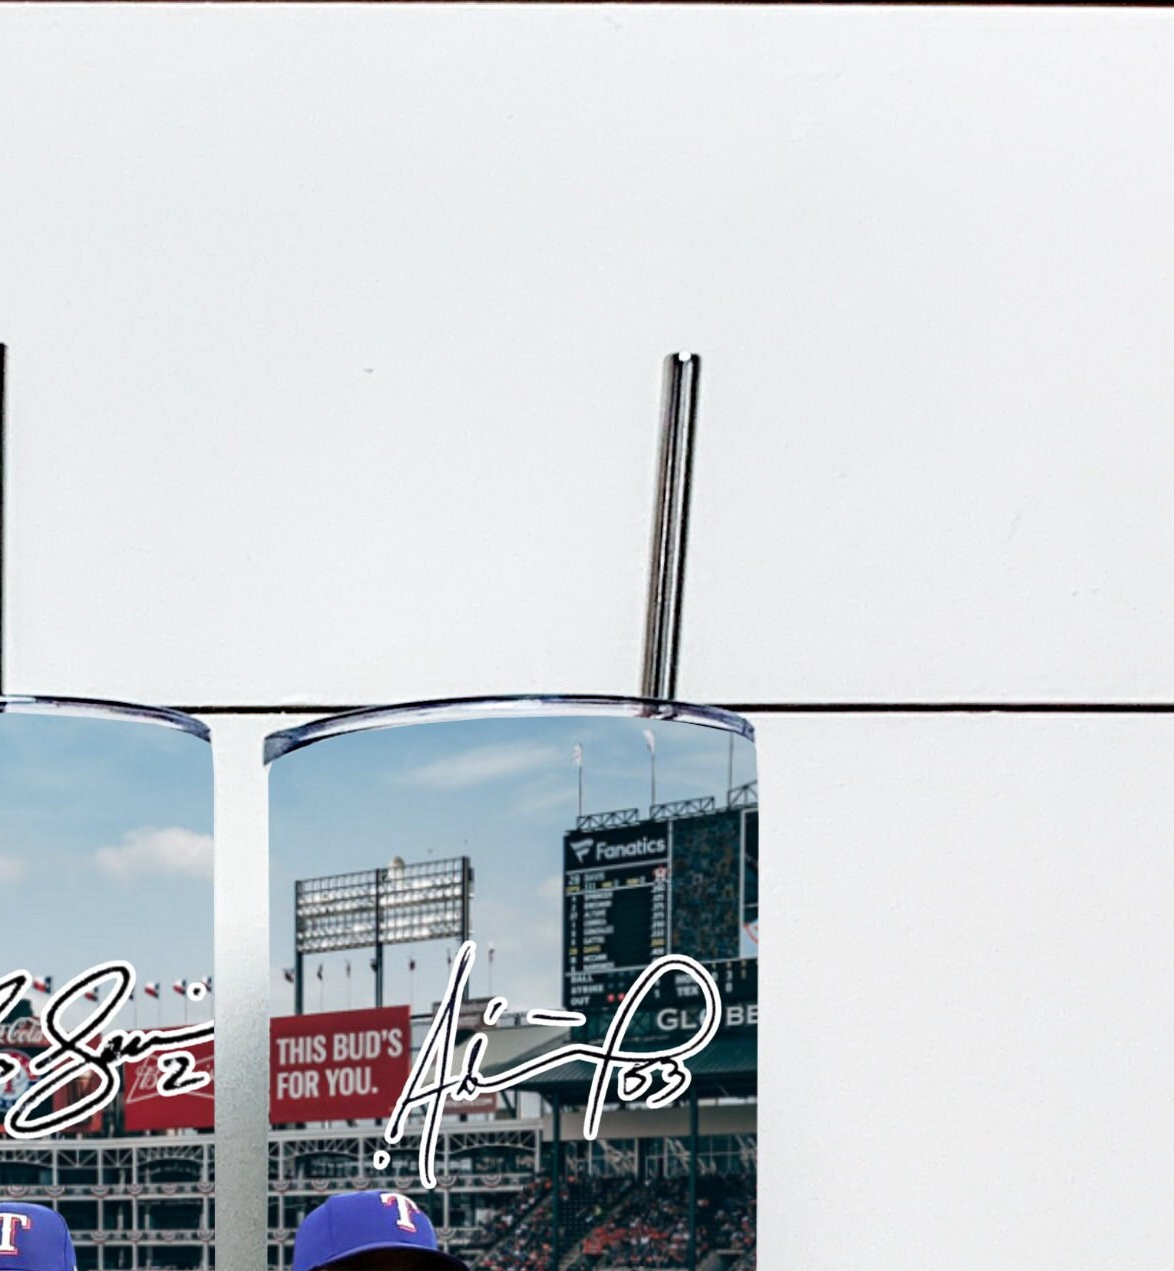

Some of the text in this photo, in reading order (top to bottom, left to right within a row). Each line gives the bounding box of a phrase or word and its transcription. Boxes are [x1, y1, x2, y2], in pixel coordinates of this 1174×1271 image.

[596, 837, 665, 861] Fanatics
[570, 996, 590, 1006] OUT
[571, 984, 604, 994] STRIKE
[276, 1028, 403, 1066] THIS BUD'S
[277, 1066, 378, 1100] FOR YOU.
